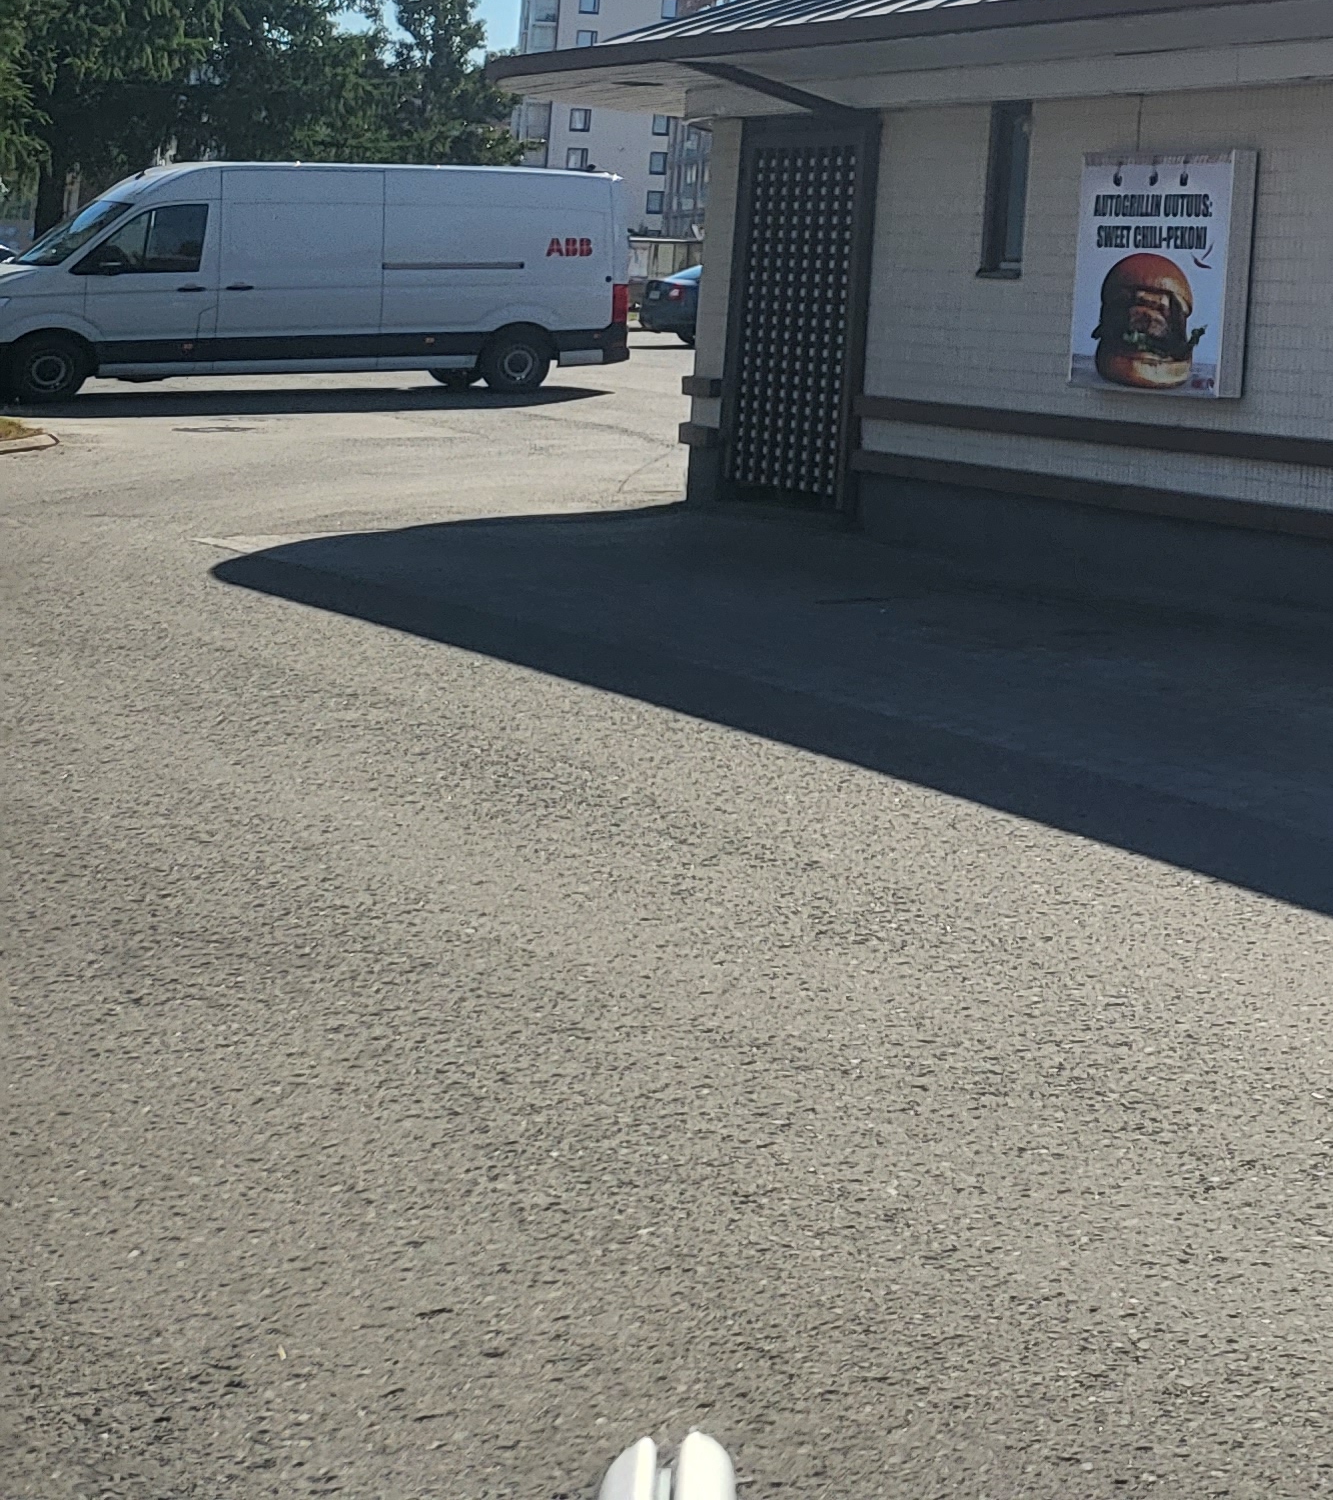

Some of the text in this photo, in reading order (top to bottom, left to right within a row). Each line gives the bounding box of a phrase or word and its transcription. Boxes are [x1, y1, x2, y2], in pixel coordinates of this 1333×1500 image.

[1094, 193, 1213, 217] AUTOGRILLIN UUTUUS:
[545, 237, 593, 257] ABB
[1096, 225, 1208, 249] SWEET CHILI-PEKONI
